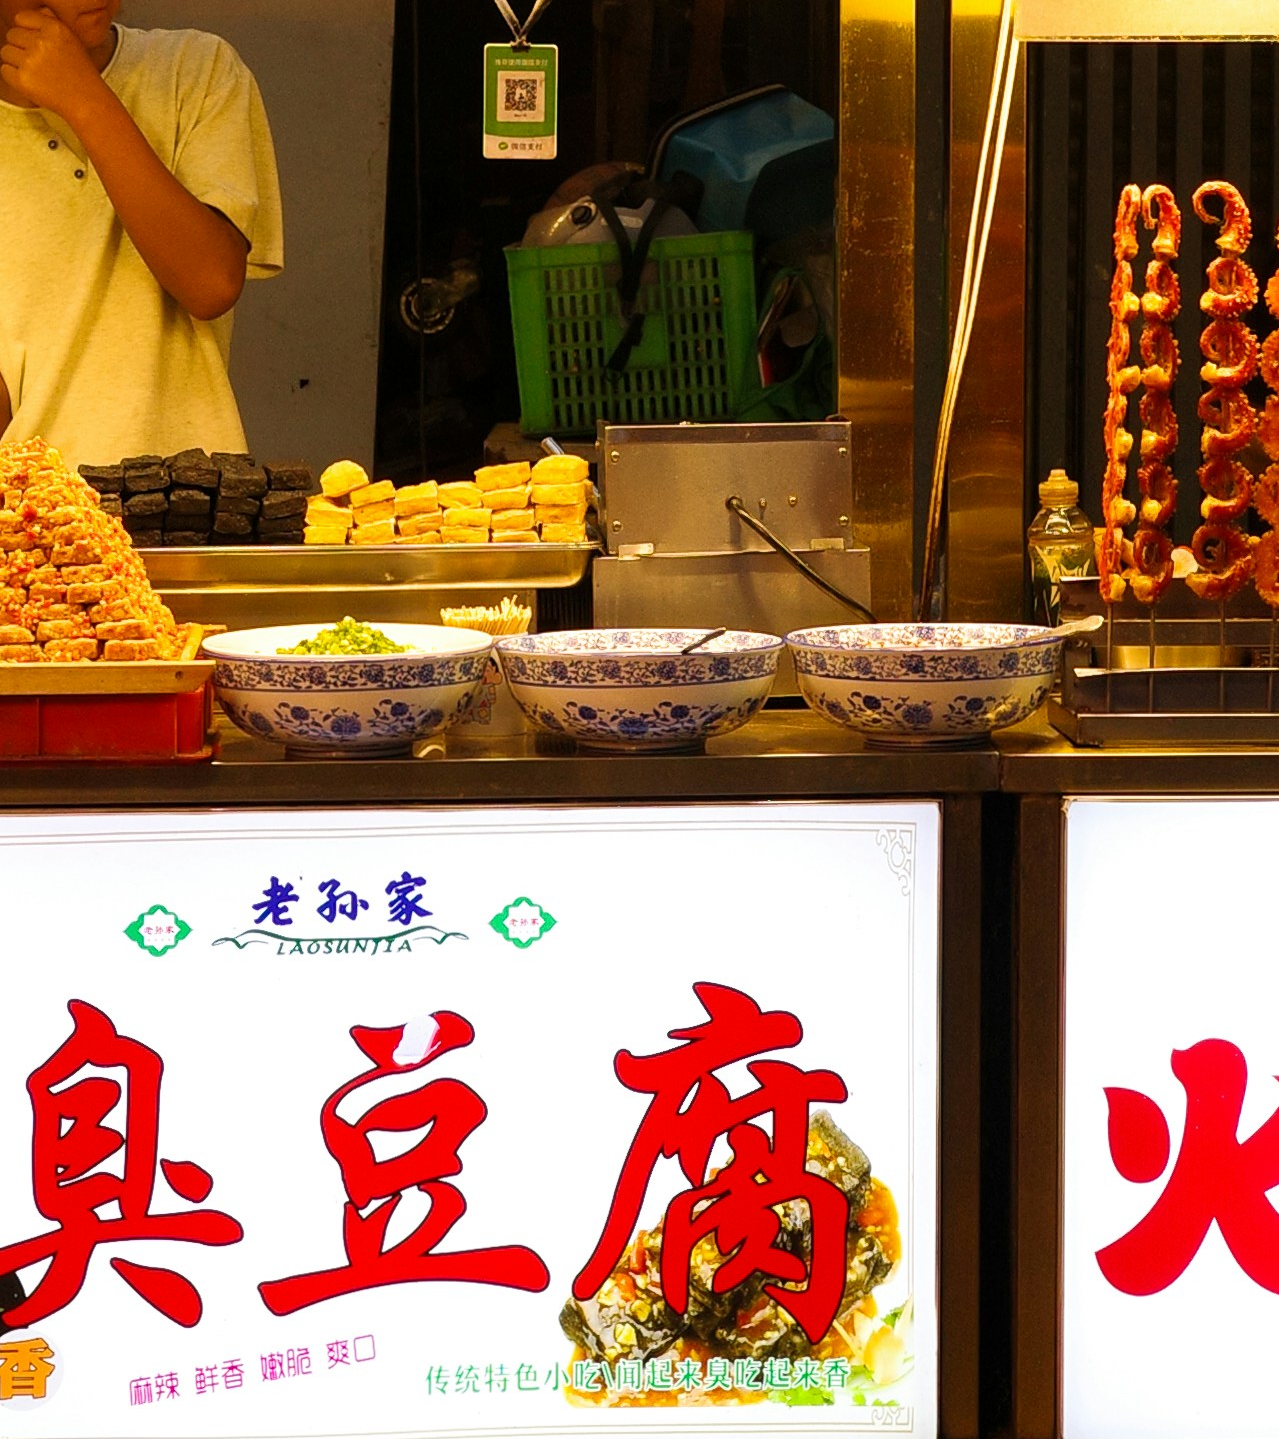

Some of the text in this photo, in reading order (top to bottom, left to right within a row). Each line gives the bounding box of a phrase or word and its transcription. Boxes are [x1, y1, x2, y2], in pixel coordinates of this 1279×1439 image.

[252, 871, 433, 926] 老孙家
[274, 938, 412, 956] LAOSUNJIA
[129, 1371, 180, 1406] 麻辣
[194, 1357, 245, 1396] 鲜香
